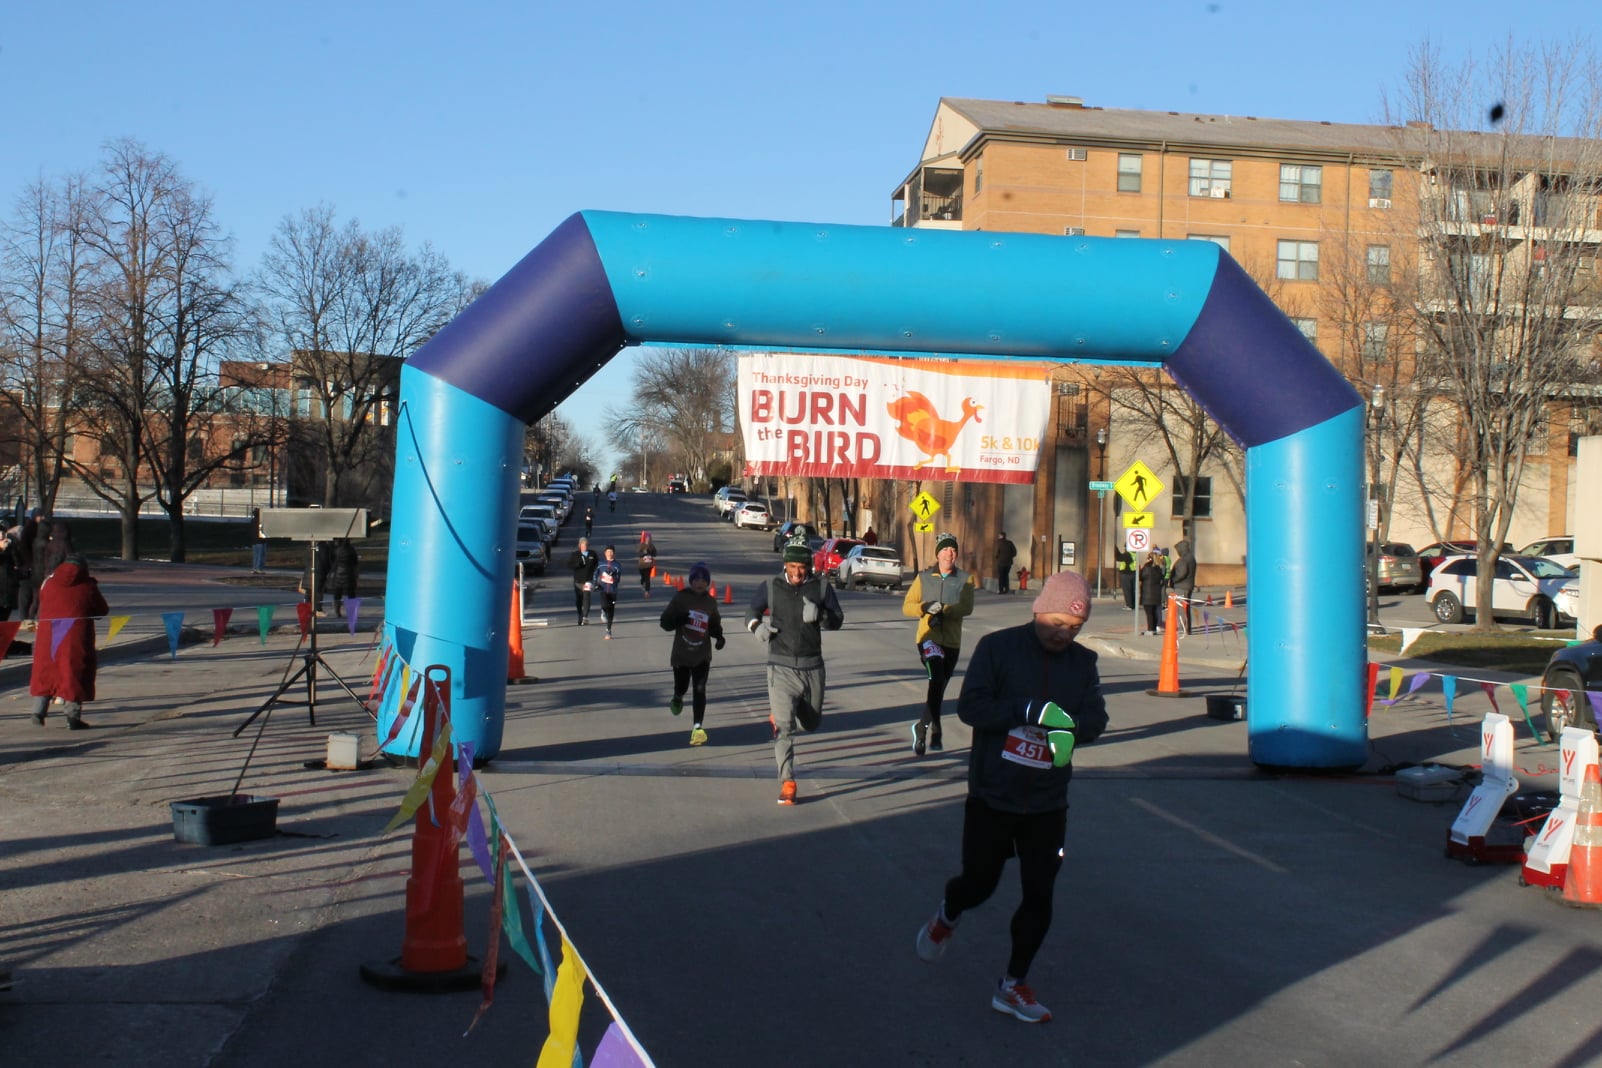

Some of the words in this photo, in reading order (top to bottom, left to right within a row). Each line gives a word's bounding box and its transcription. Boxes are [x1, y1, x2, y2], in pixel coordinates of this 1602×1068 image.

[752, 372, 840, 389] Thanksgiving
[844, 375, 869, 390] Day
[751, 389, 867, 427] BURN
[757, 427, 783, 441] the
[980, 435, 998, 449] 5k
[1002, 436, 1013, 450] &
[786, 429, 881, 466] BIRD
[980, 455, 1005, 465] Fargo,
[1008, 456, 1020, 464] ND
[1016, 742, 1045, 759] 451
